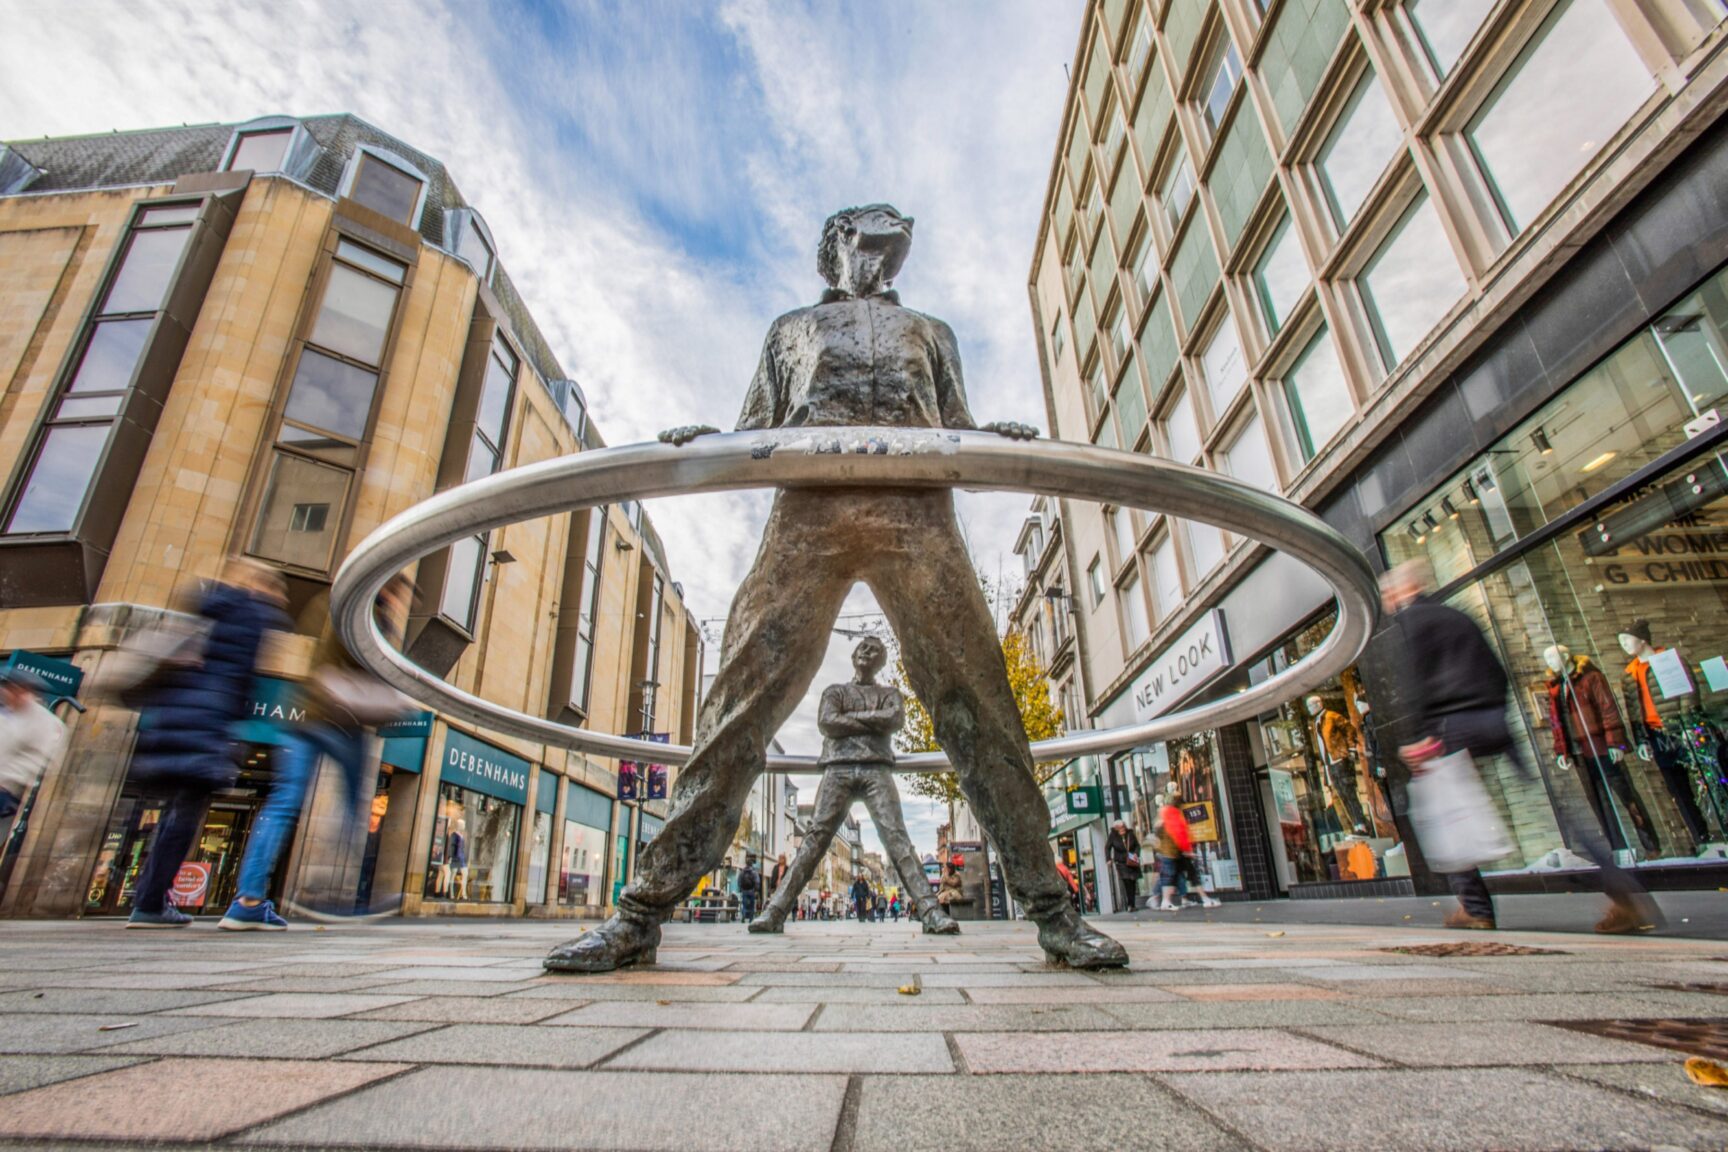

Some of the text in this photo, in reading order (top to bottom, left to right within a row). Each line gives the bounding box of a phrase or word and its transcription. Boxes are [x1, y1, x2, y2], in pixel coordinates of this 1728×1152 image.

[1605, 563, 1630, 585] G
[17, 663, 74, 685] DEBENHAMS
[1136, 632, 1212, 712] NEW LOOK
[449, 747, 525, 790] DEBENHAMS
